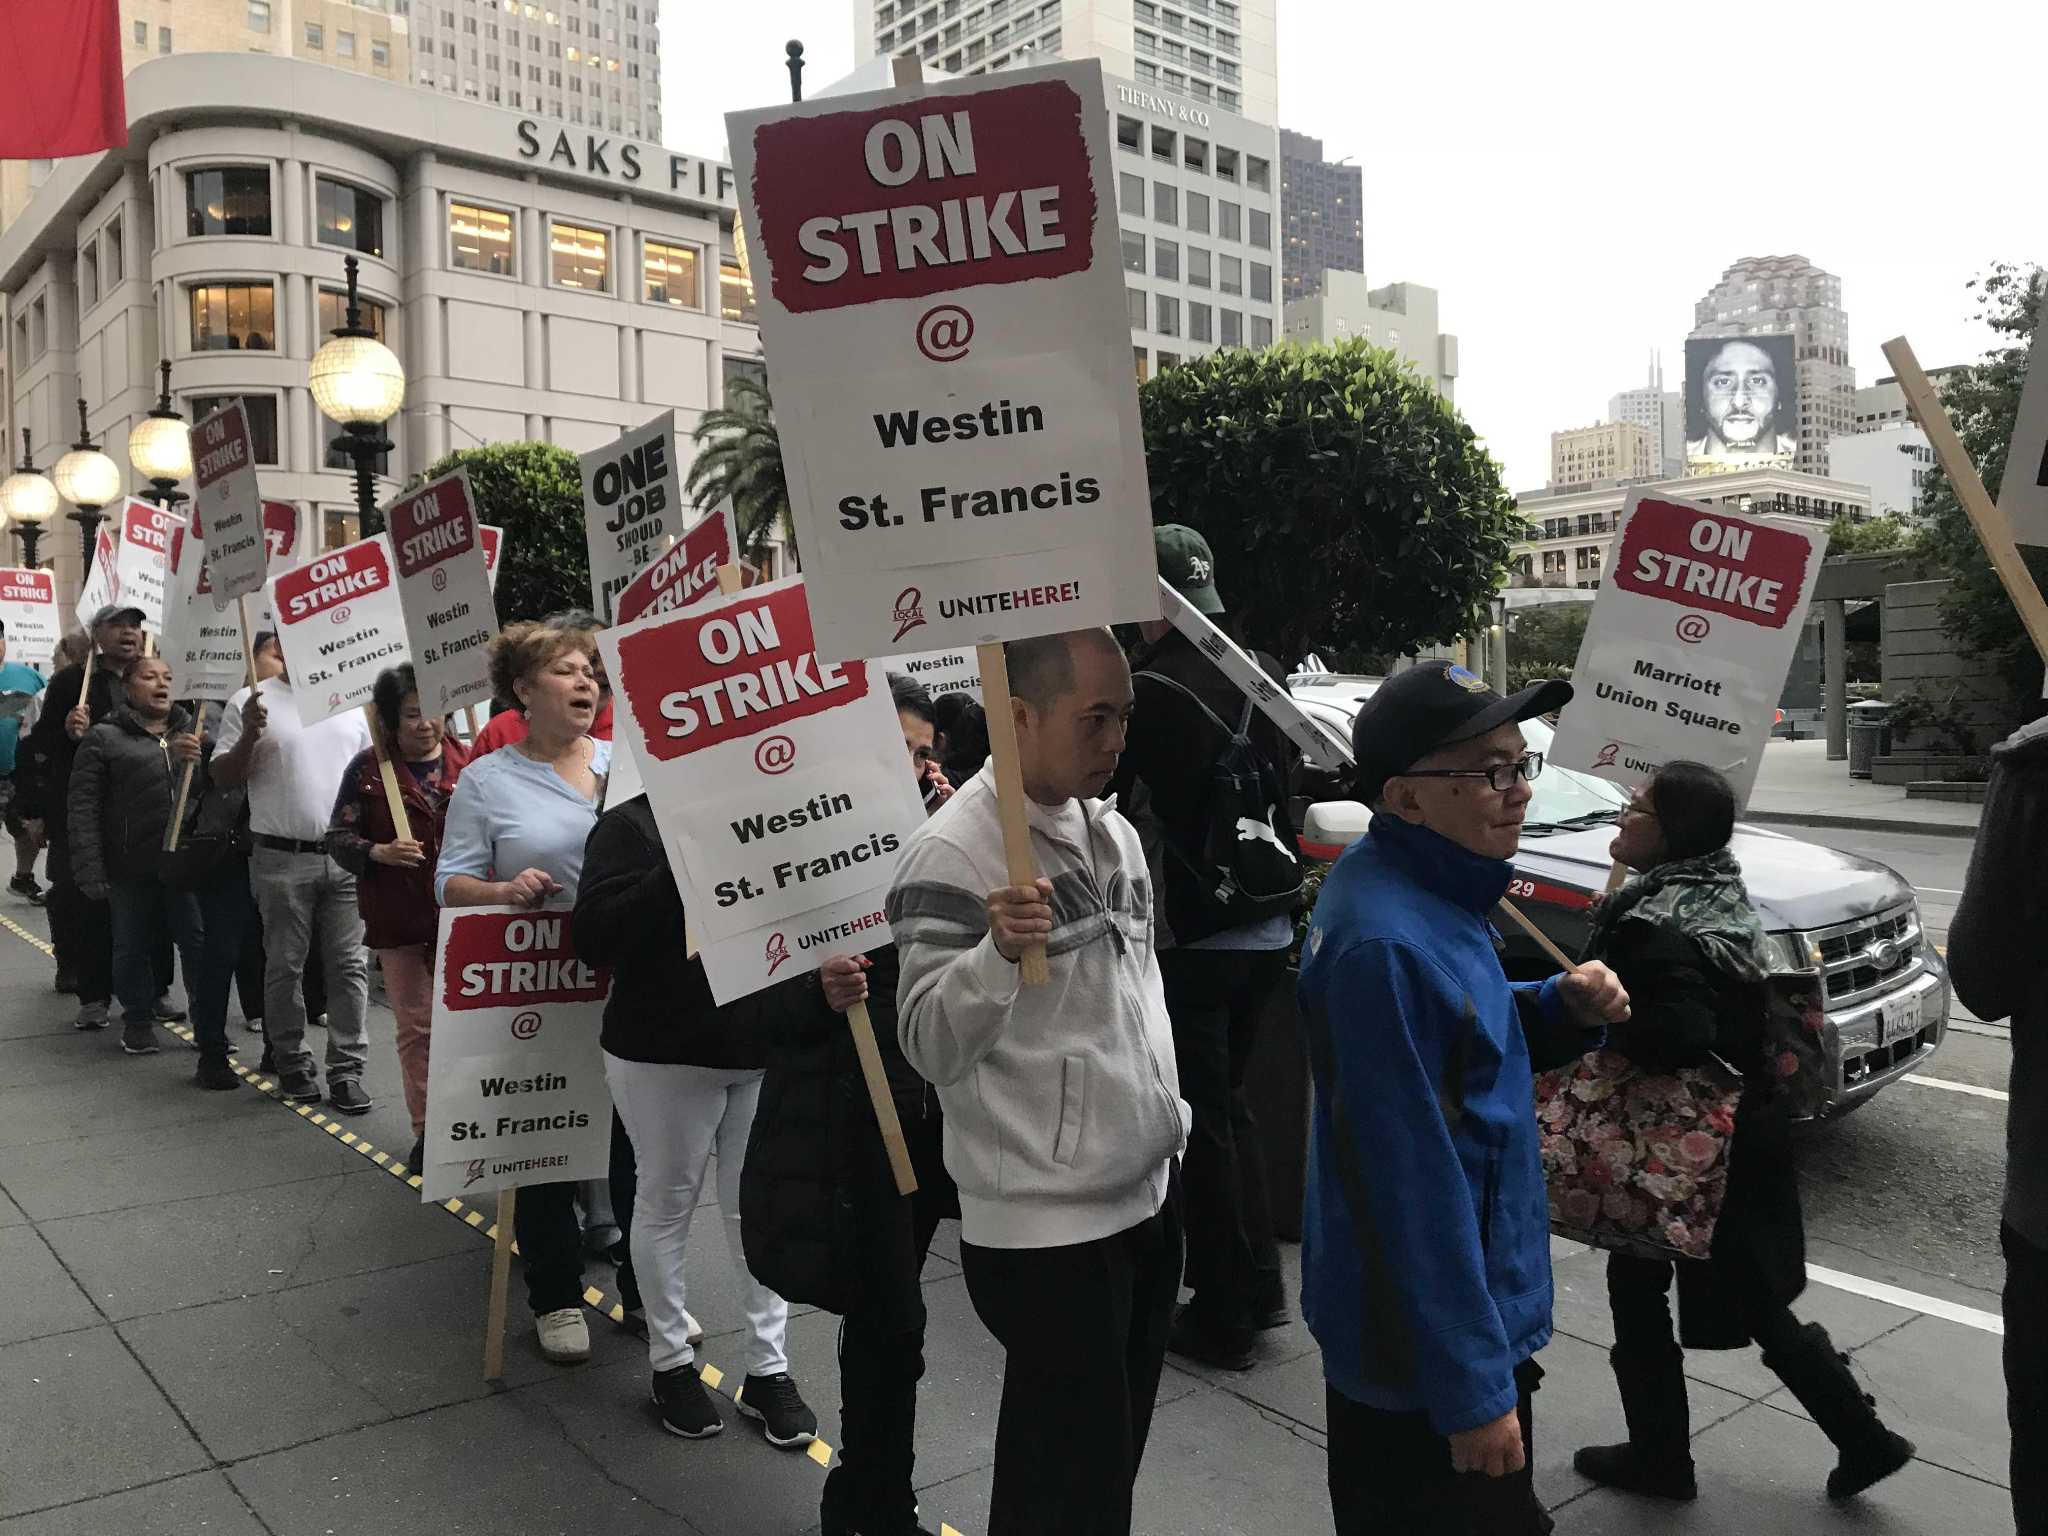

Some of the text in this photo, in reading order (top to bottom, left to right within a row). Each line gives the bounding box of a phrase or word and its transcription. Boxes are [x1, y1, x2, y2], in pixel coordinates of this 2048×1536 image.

[1117, 84, 1177, 117] TIFFANY
[1178, 104, 1188, 122] &
[517, 120, 642, 180] SAKS
[864, 110, 977, 187] ON
[799, 185, 1067, 284] STRIKE
[916, 304, 974, 362] @
[206, 418, 225, 446] ON
[873, 400, 1044, 448] Westin
[199, 438, 244, 479] STRIKE
[592, 433, 668, 506] ONE
[412, 492, 441, 525] ON
[606, 484, 666, 532] JOB
[838, 472, 1101, 530] St. Francis
[402, 516, 467, 567] STRIKE
[616, 518, 663, 552] SHOULD
[1688, 519, 1753, 562] ON
[15, 573, 34, 586] ON
[309, 555, 348, 583] ON
[641, 551, 717, 618] TRIKE
[651, 543, 688, 591] ON
[1632, 549, 1784, 614] STRIKE
[3, 585, 48, 599] STRIKE
[289, 566, 380, 616] STRIKE
[939, 581, 1080, 619] UNITEHERE!
[199, 626, 237, 638] Westin
[330, 606, 351, 625] @
[427, 602, 470, 629] Westin
[698, 605, 780, 665] ON
[1676, 614, 1710, 644] @
[185, 649, 243, 663] St. Francis
[318, 626, 380, 656] Westin
[424, 628, 490, 665] St. Francis
[307, 641, 404, 686] St. Francis
[906, 655, 965, 673] Westin
[1632, 659, 1723, 697] Marriott
[659, 651, 850, 739] STRIKE
[1595, 682, 1742, 735] Union Square
[754, 735, 796, 775] @
[730, 790, 853, 845] Westin
[714, 829, 900, 908] St. Francis
[1508, 879, 1535, 897] 29
[504, 919, 561, 952] ON
[460, 958, 597, 998] STRIKE
[511, 1011, 542, 1041] @
[480, 1072, 567, 1098] Westin
[450, 1110, 589, 1142] St. Francis
[492, 1154, 568, 1175] UNITEHERE!
